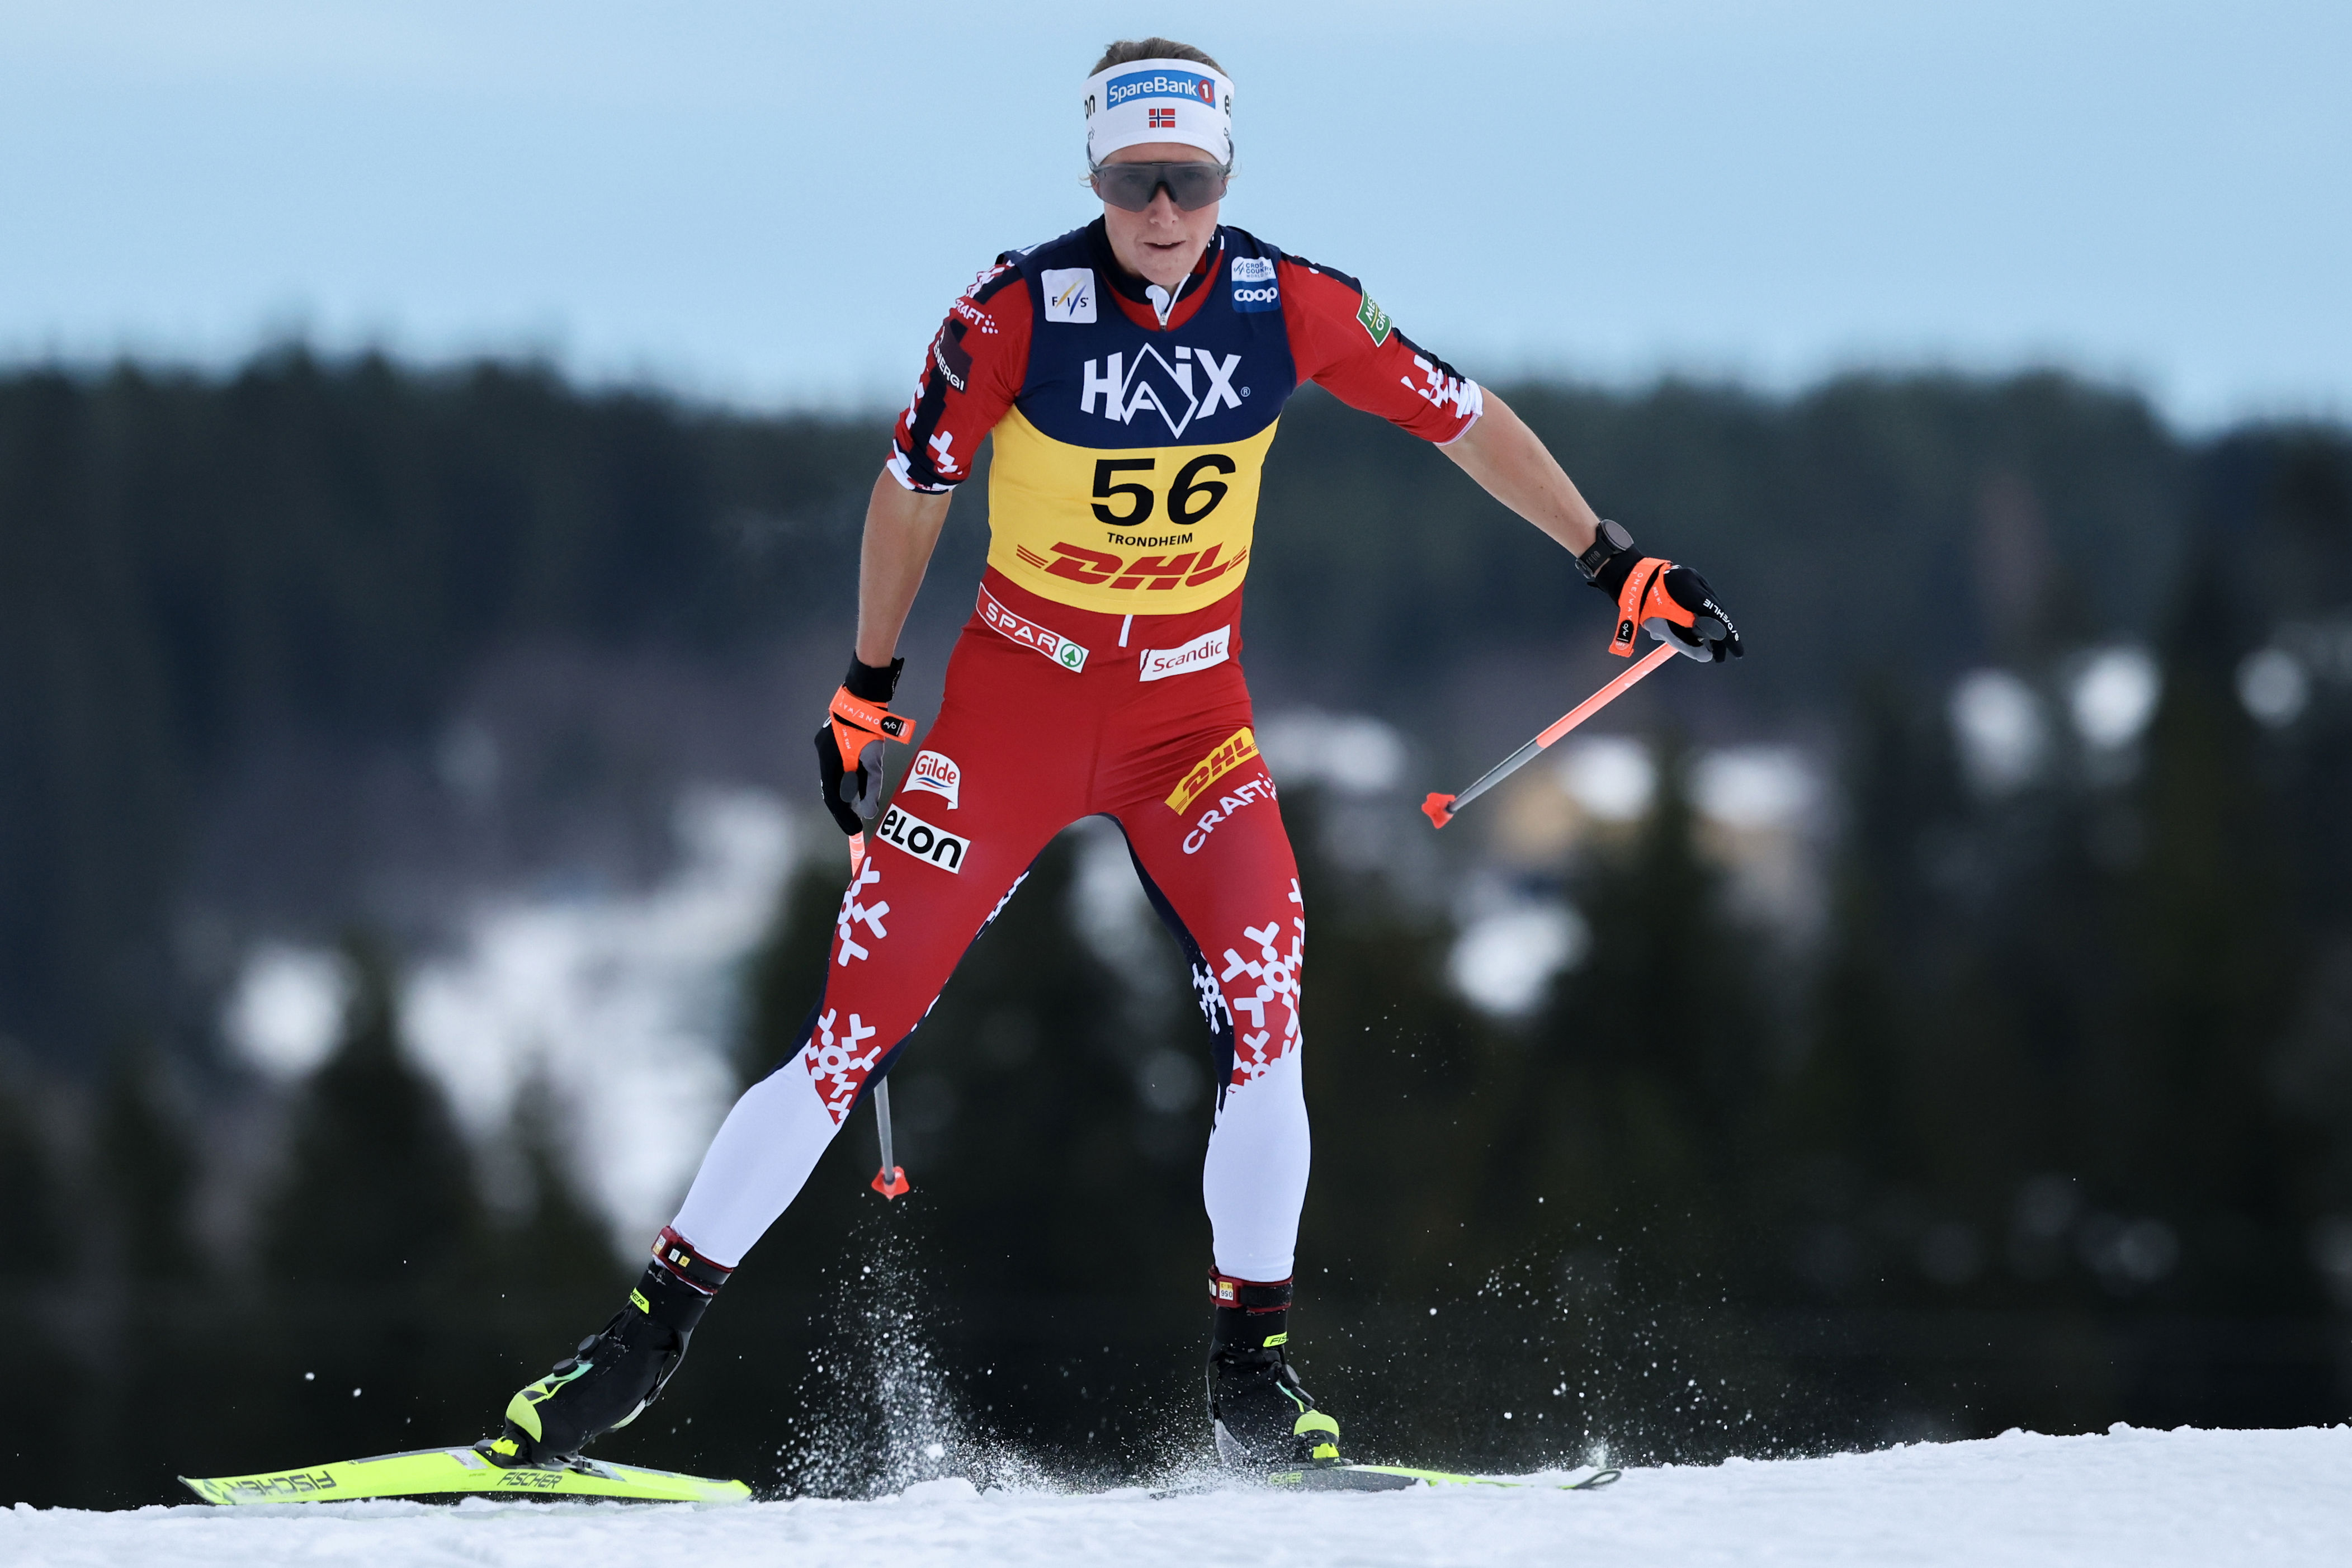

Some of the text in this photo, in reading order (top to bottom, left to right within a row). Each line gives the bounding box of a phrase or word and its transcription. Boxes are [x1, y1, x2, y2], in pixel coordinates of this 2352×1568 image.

[1109, 77, 1197, 102] SpareBank
[1234, 287, 1278, 303] coop
[933, 339, 965, 391] ENERGI
[1090, 454, 1236, 526] 56
[1107, 532, 1193, 547] TRONDHEIM
[1044, 541, 1232, 591] DHL
[986, 602, 1057, 653] SPAR
[1153, 640, 1223, 672] Scandic
[915, 755, 957, 785] Gilde
[1183, 736, 1252, 800] DHL
[1183, 780, 1269, 855] CRAFT
[497, 1472, 563, 1489] FISCHER
